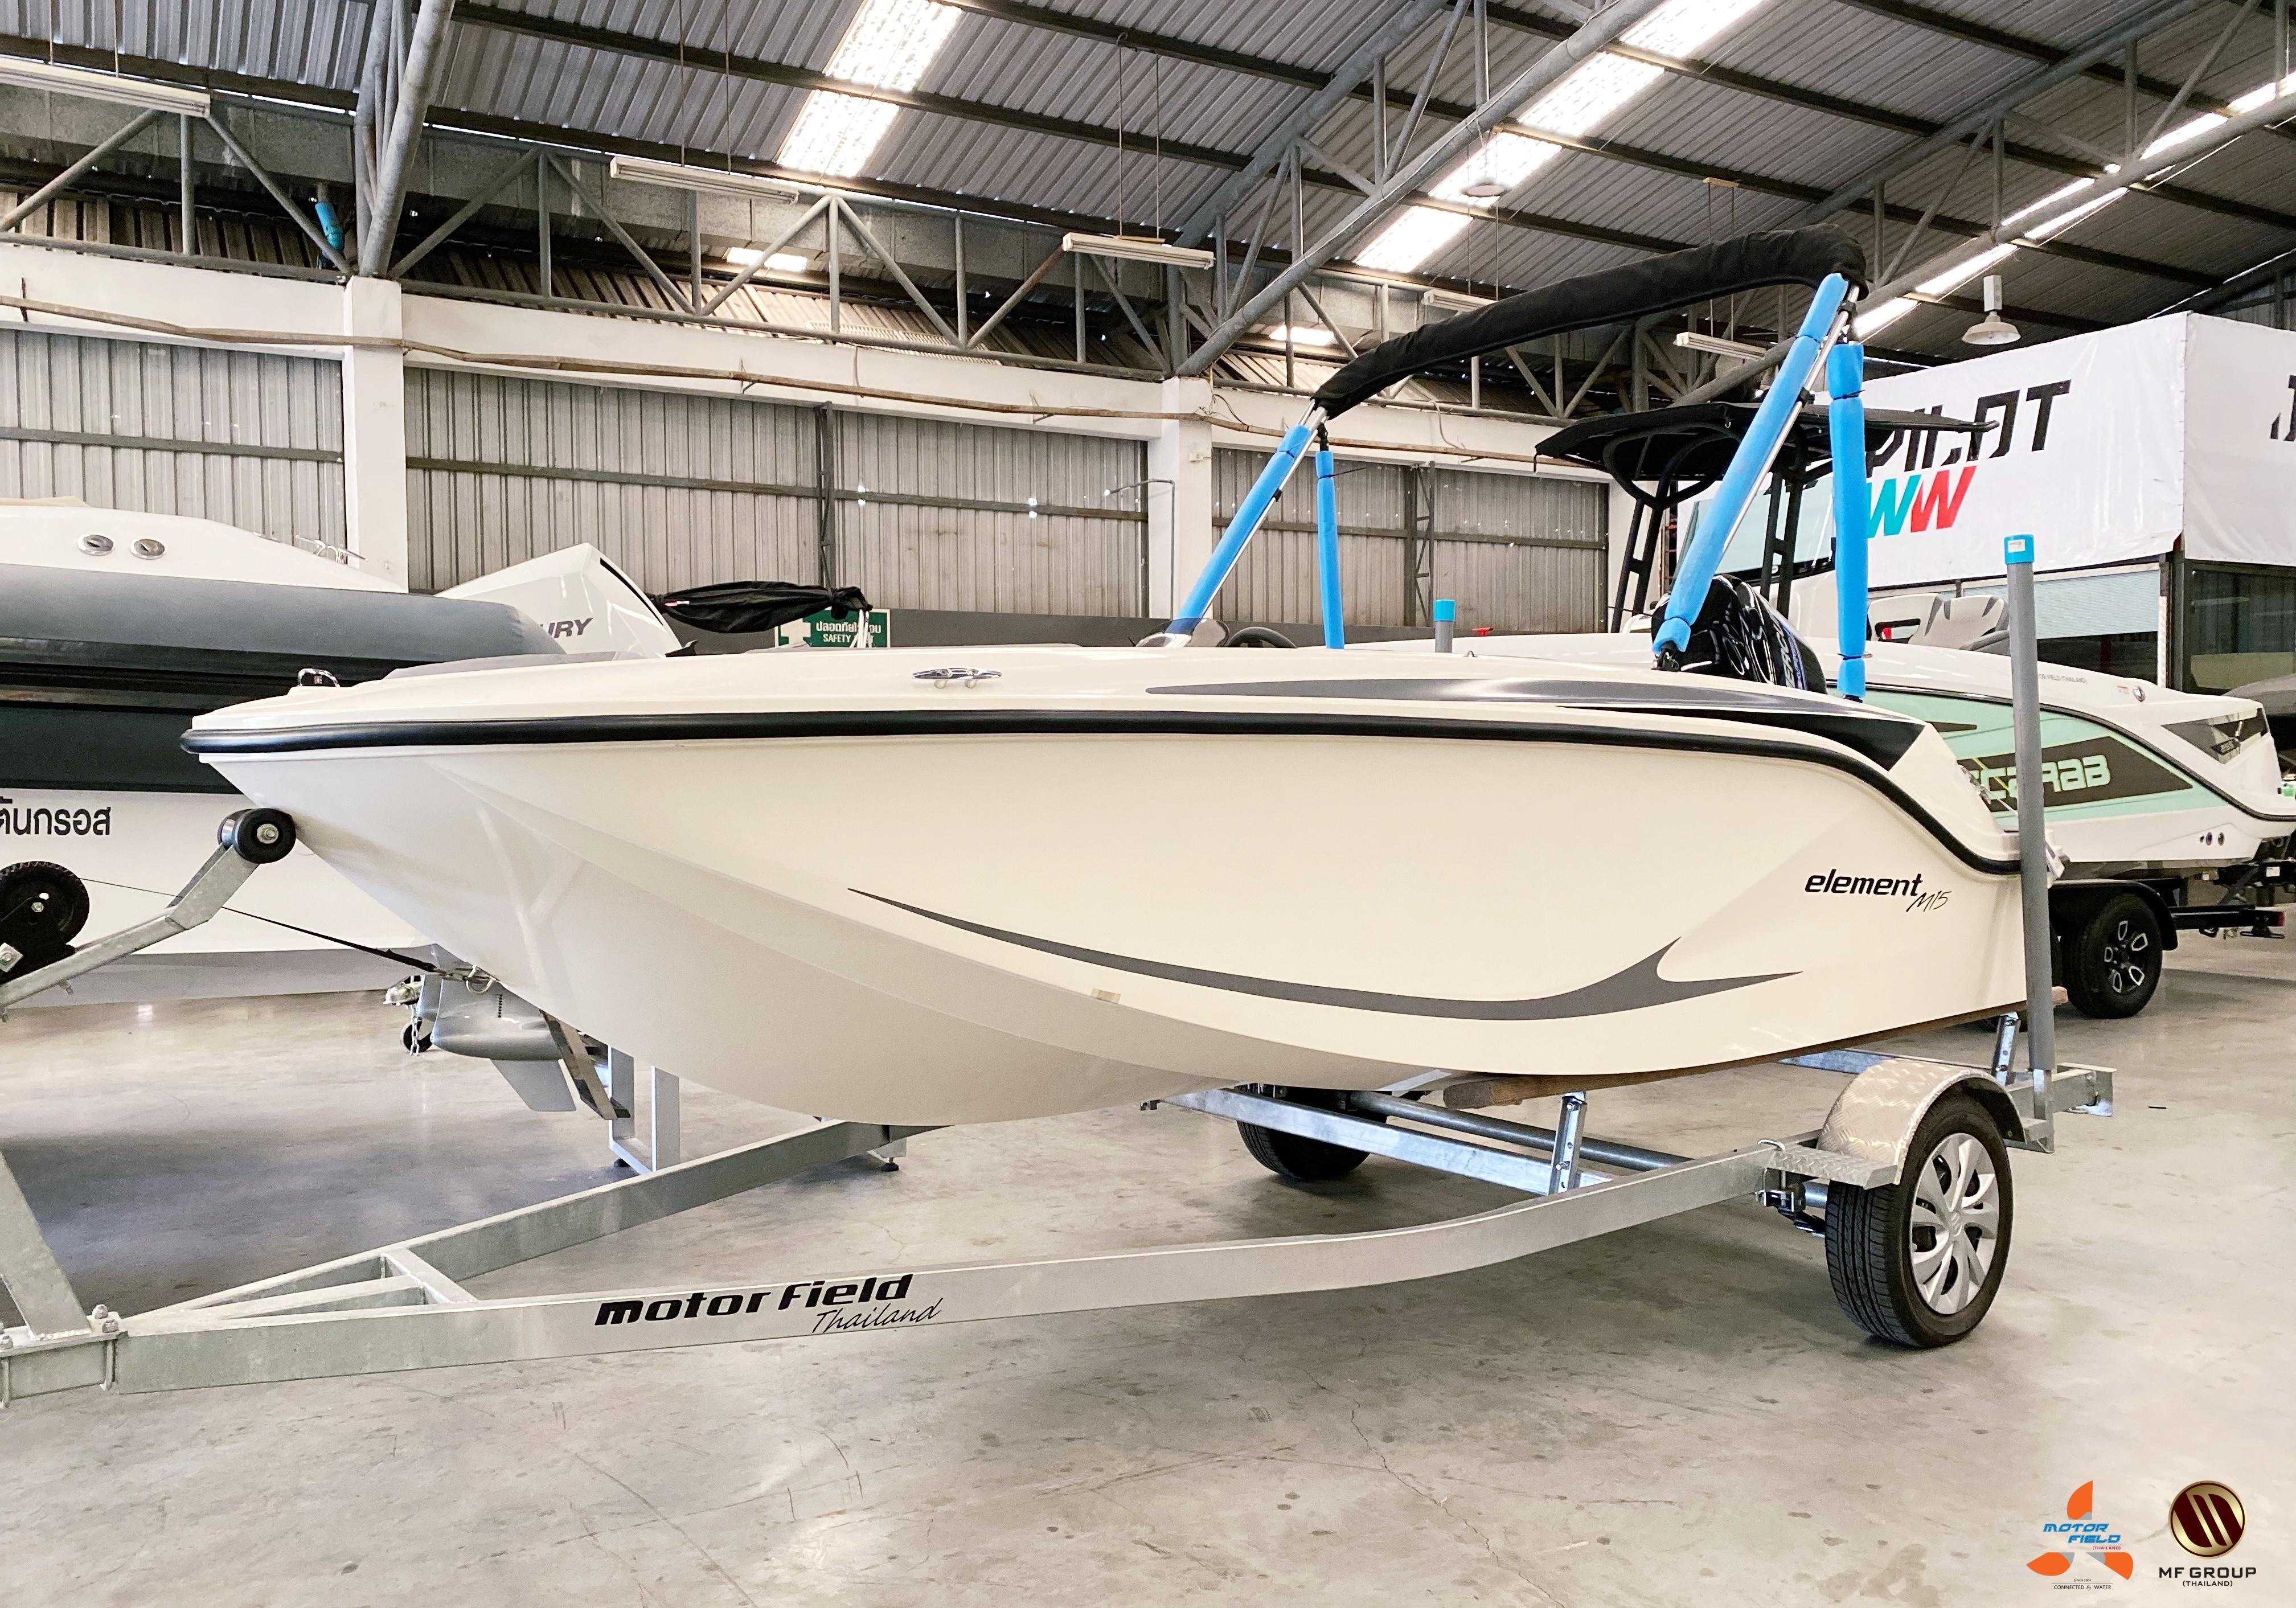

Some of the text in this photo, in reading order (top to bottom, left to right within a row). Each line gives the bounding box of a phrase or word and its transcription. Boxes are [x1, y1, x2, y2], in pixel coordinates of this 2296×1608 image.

[823, 634, 851, 643] SAFETY
[1805, 869, 1953, 912] element M15
[594, 1274, 913, 1326] motor Field
[812, 1297, 944, 1333] Thailand
